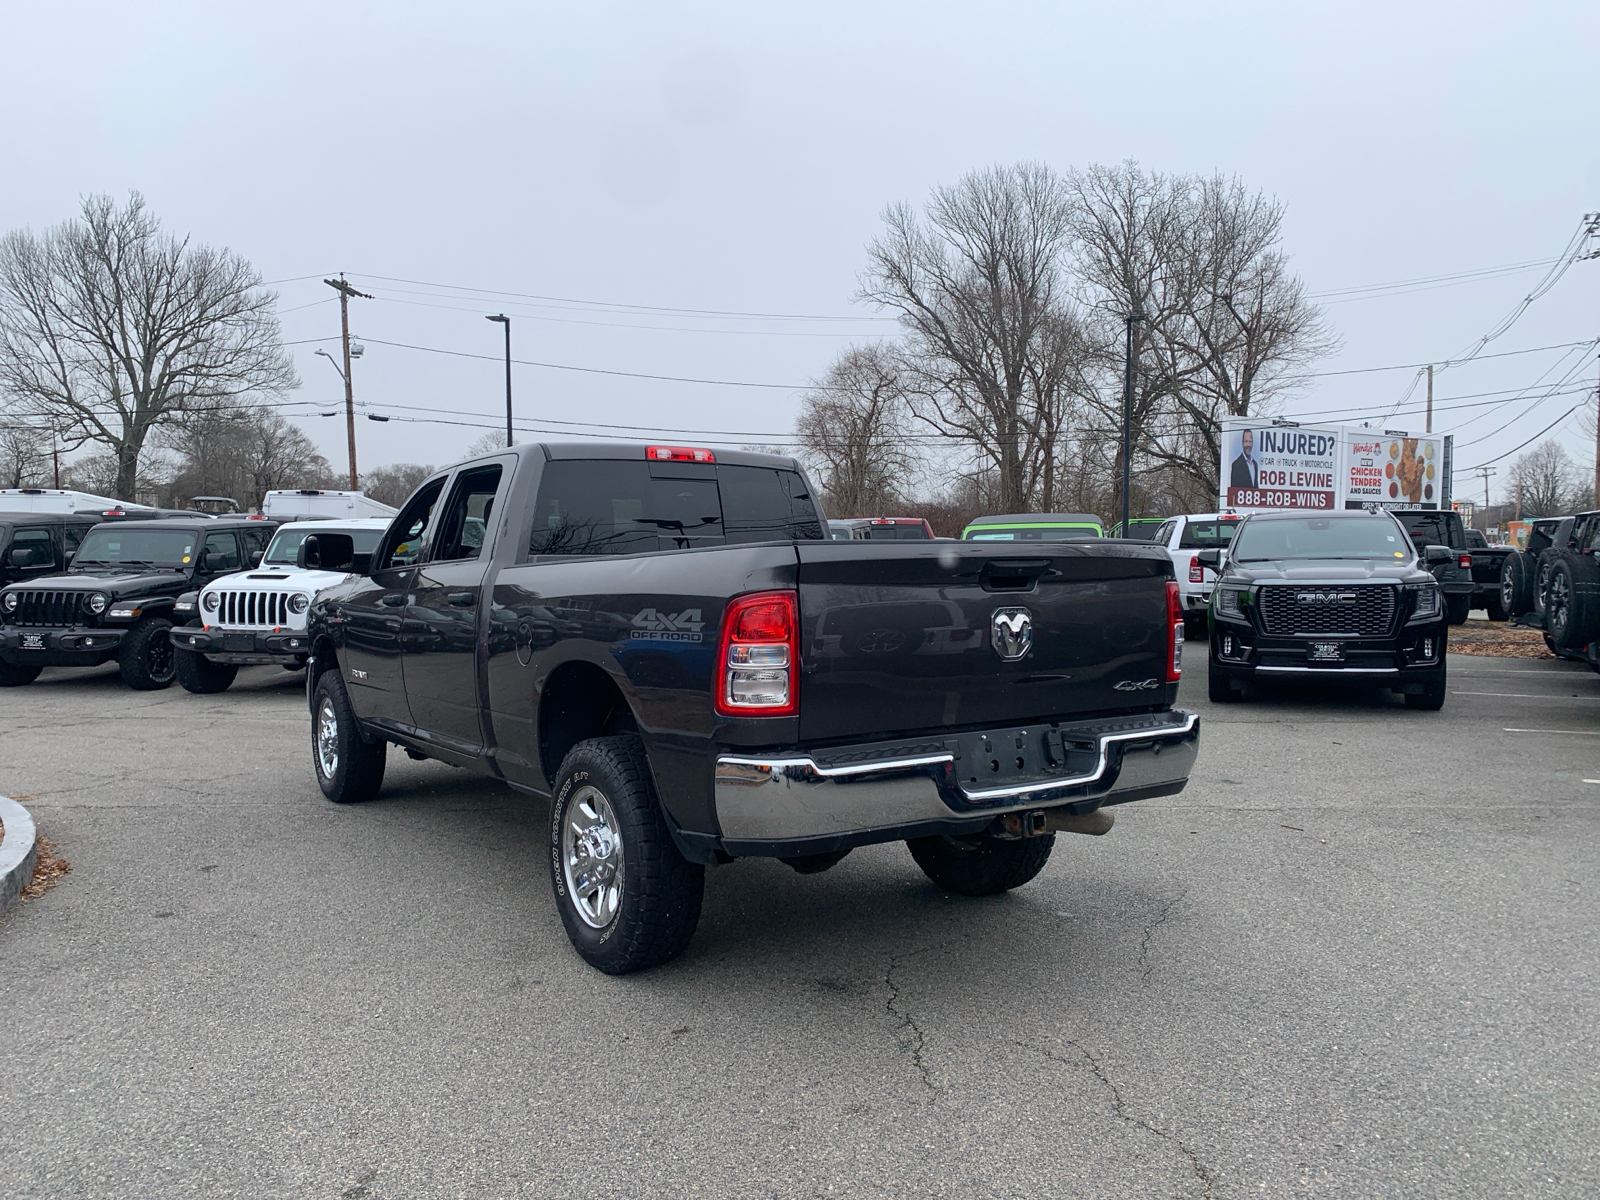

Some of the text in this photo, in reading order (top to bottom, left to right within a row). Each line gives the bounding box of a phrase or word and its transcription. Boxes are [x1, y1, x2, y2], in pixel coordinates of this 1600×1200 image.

[1260, 431, 1335, 456] INJURED?
[1353, 442, 1373, 455] Wendy's
[1265, 457, 1333, 469] CAR TRUCK MOTORCYCLE
[1350, 467, 1382, 476] CHICKEN
[1259, 470, 1333, 488] ROB LEVINE
[1350, 477, 1382, 487] TENDERS
[1237, 490, 1327, 507] 888-ROB-WINS
[1297, 593, 1356, 604] GMC
[632, 631, 702, 641] OFF ROAD
[551, 778, 572, 844] COUNTRY
[552, 847, 565, 896] OPEN
